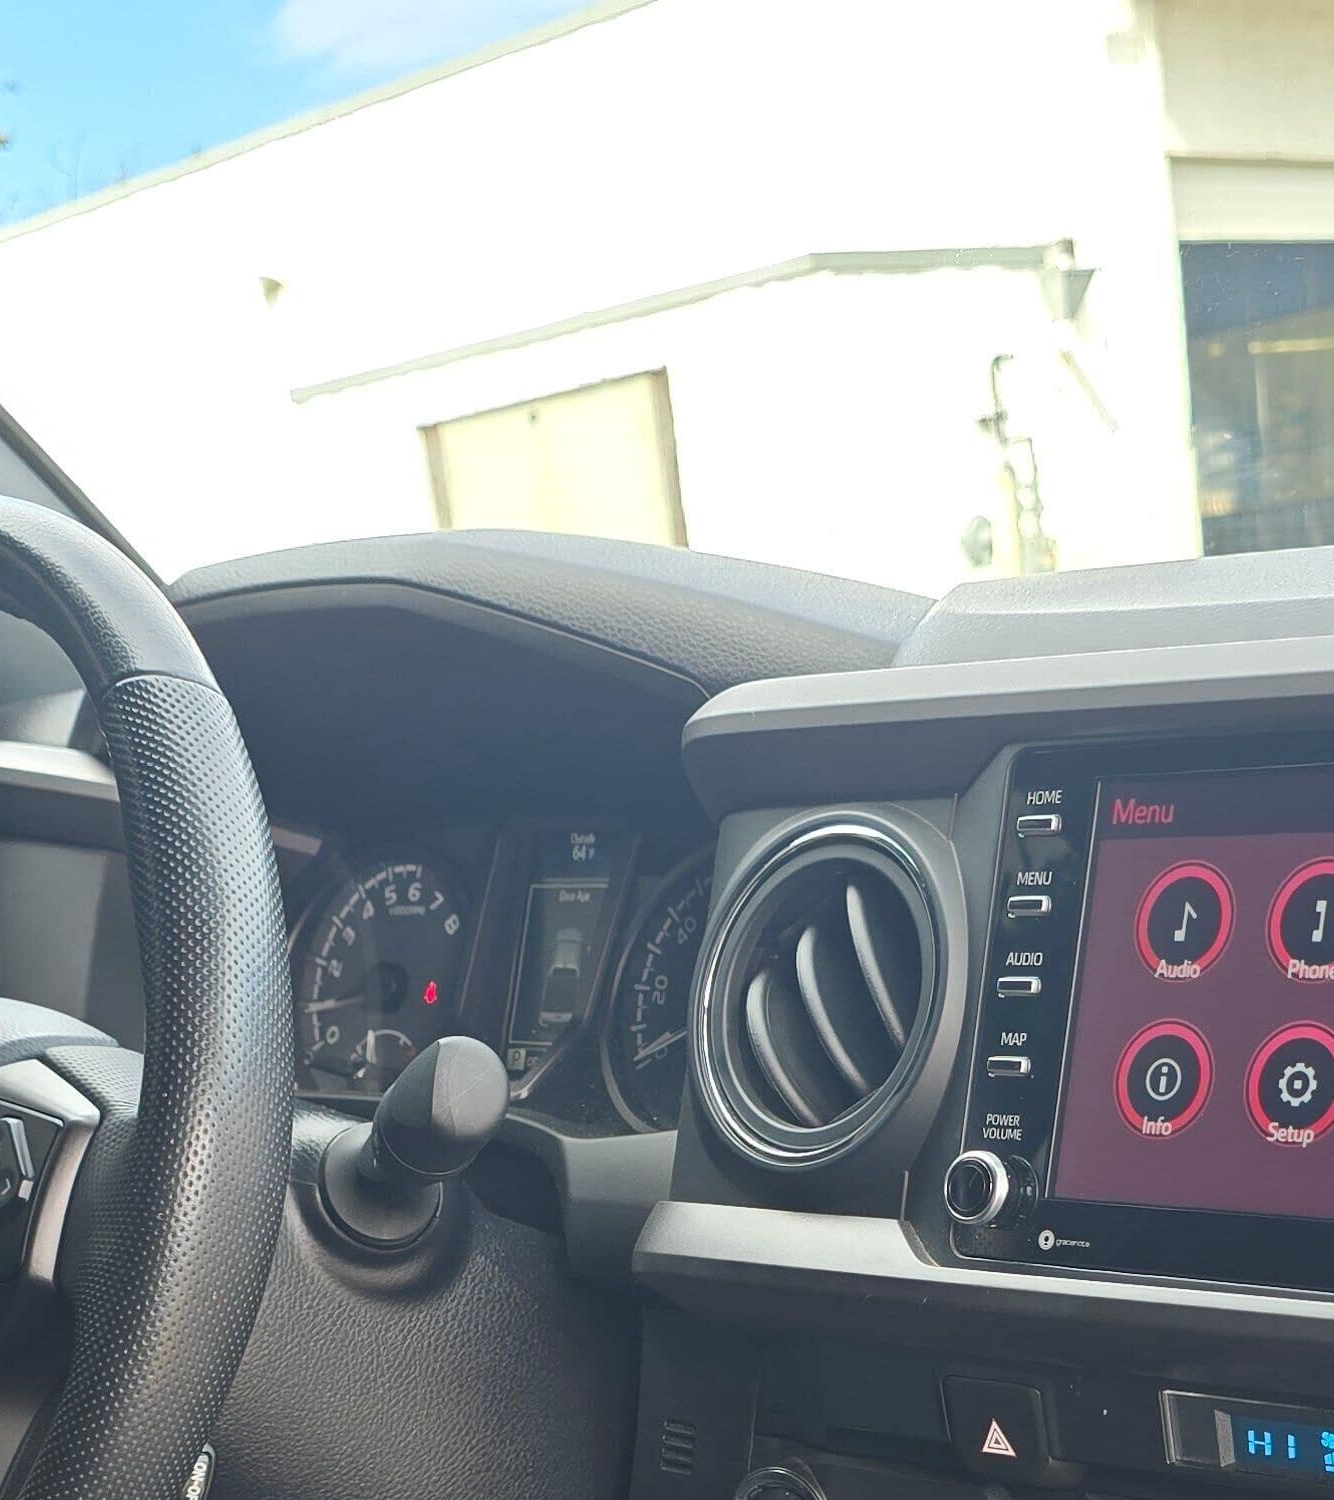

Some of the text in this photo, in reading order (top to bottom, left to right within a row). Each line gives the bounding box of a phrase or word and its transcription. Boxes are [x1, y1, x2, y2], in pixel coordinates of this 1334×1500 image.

[1027, 790, 1062, 805] HOME
[1112, 798, 1175, 825] Menu
[1017, 871, 1052, 886] MENU
[385, 885, 398, 905] 5
[408, 882, 422, 901] 6
[430, 891, 444, 910] 7
[444, 914, 459, 935] 8
[678, 916, 696, 944] 40
[1006, 952, 1043, 966] AUDIO
[1154, 959, 1201, 980] Audio
[652, 975, 668, 1005] 20
[1000, 1032, 1027, 1046] MAP
[986, 1113, 1020, 1127] POWER
[1142, 1116, 1173, 1137] Info
[983, 1127, 1022, 1141] VOLUME
[1266, 1122, 1315, 1148] Setup
[1247, 1430, 1296, 1459] HI
